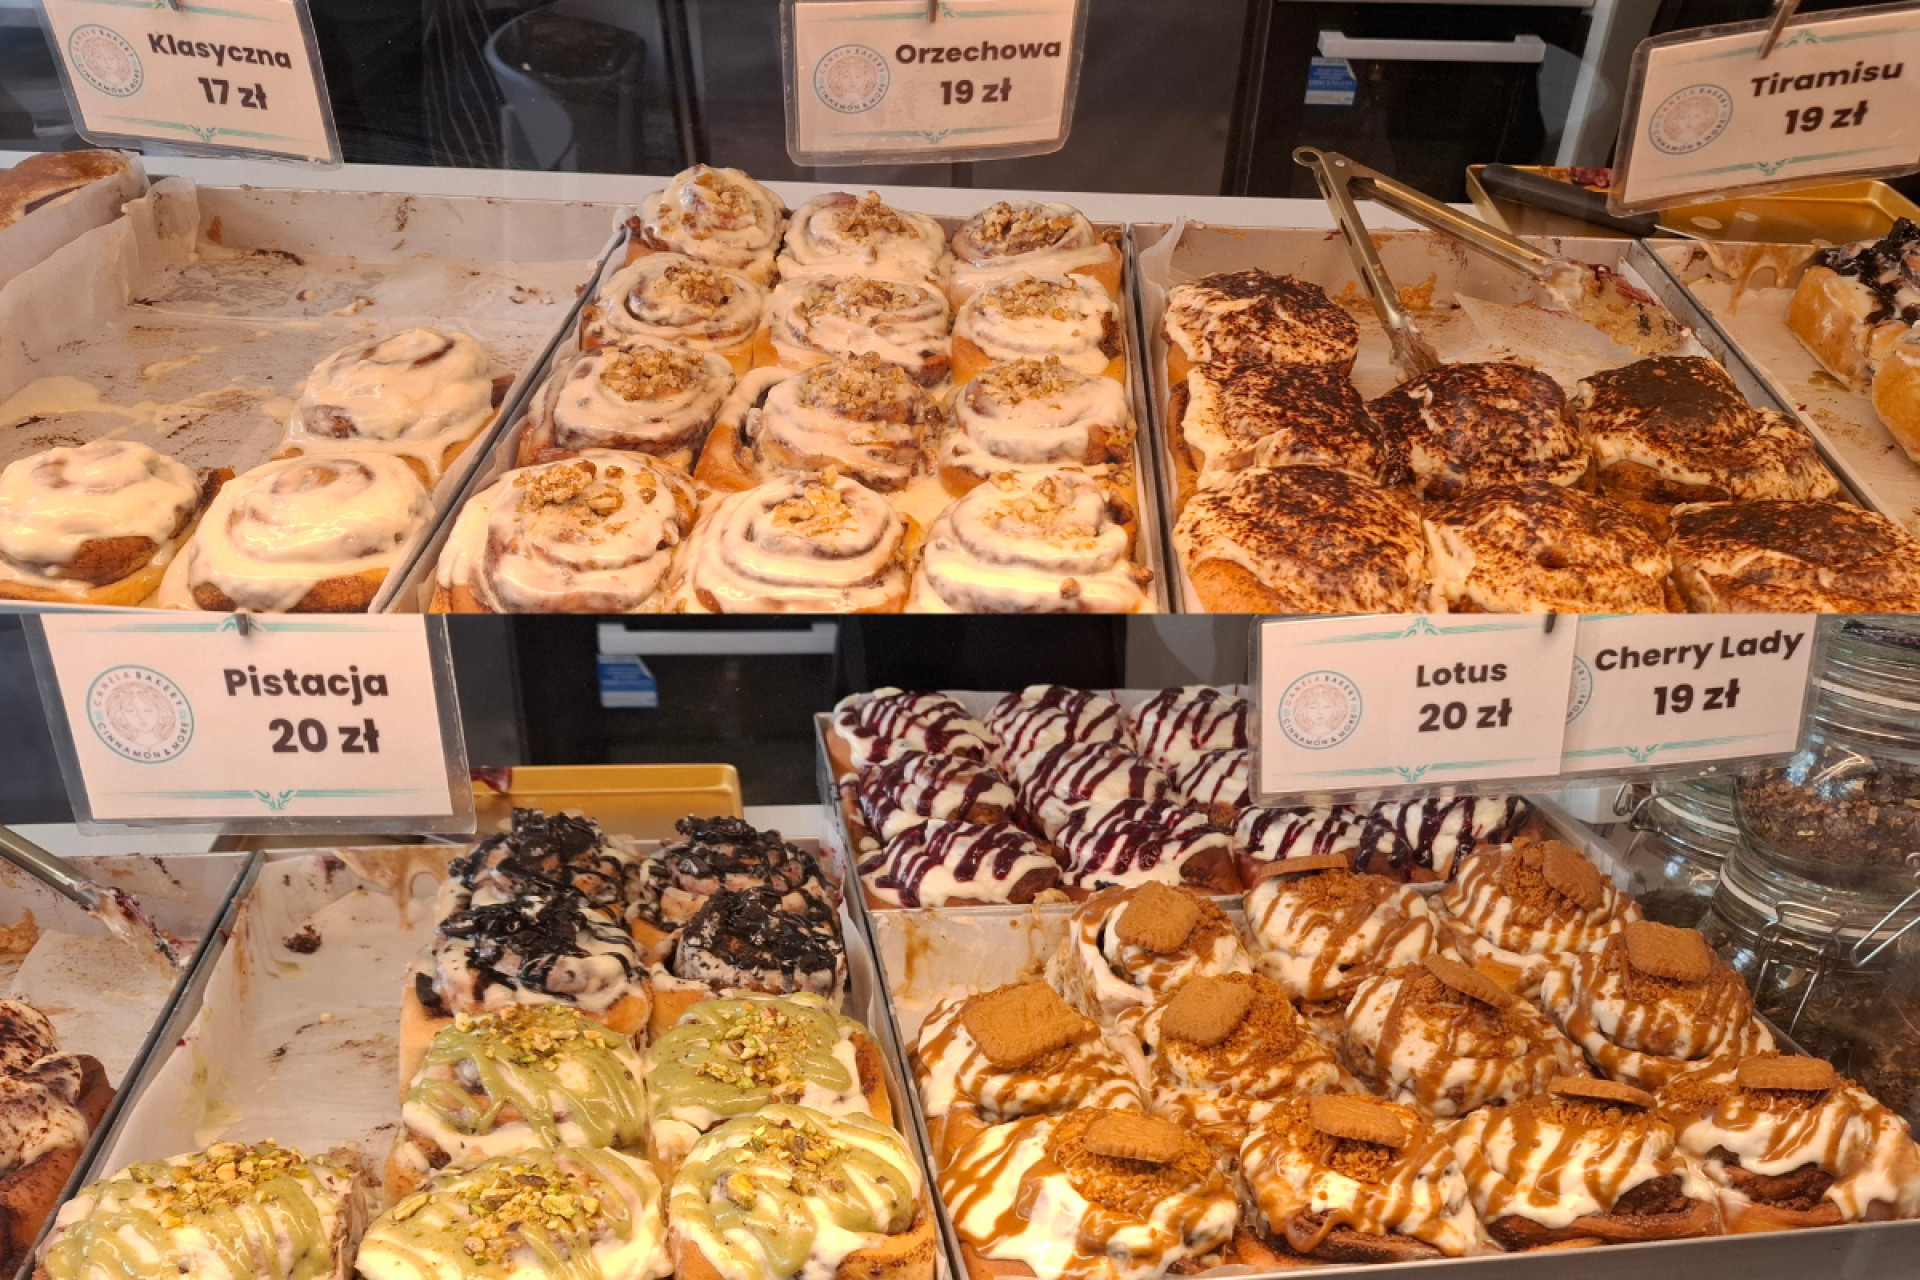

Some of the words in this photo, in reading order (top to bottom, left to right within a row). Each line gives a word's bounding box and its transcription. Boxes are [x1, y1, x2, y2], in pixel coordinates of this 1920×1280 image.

[147, 33, 292, 70] Klasyczna
[895, 40, 1062, 65] Orzechowa
[198, 77, 230, 105] 17
[237, 83, 268, 111] zł
[940, 80, 974, 105] 19
[982, 77, 1012, 103] zł
[1751, 59, 1904, 97] Tiramisu
[1785, 107, 1824, 135] 19
[1830, 100, 1869, 129] zł
[1594, 643, 1714, 671] Cherry
[1720, 630, 1805, 661] Lady
[135, 671, 184, 705] BAKERY
[223, 665, 389, 706] Pistacja
[1416, 663, 1508, 688] Lotus
[1653, 684, 1694, 716] 19
[1703, 677, 1741, 711] zł
[1418, 702, 1468, 733] 20
[1477, 697, 1513, 729] zł
[97, 722, 161, 759] CINNAMON
[171, 721, 189, 750] MORE
[268, 718, 329, 753] 20
[338, 718, 380, 753] zł
